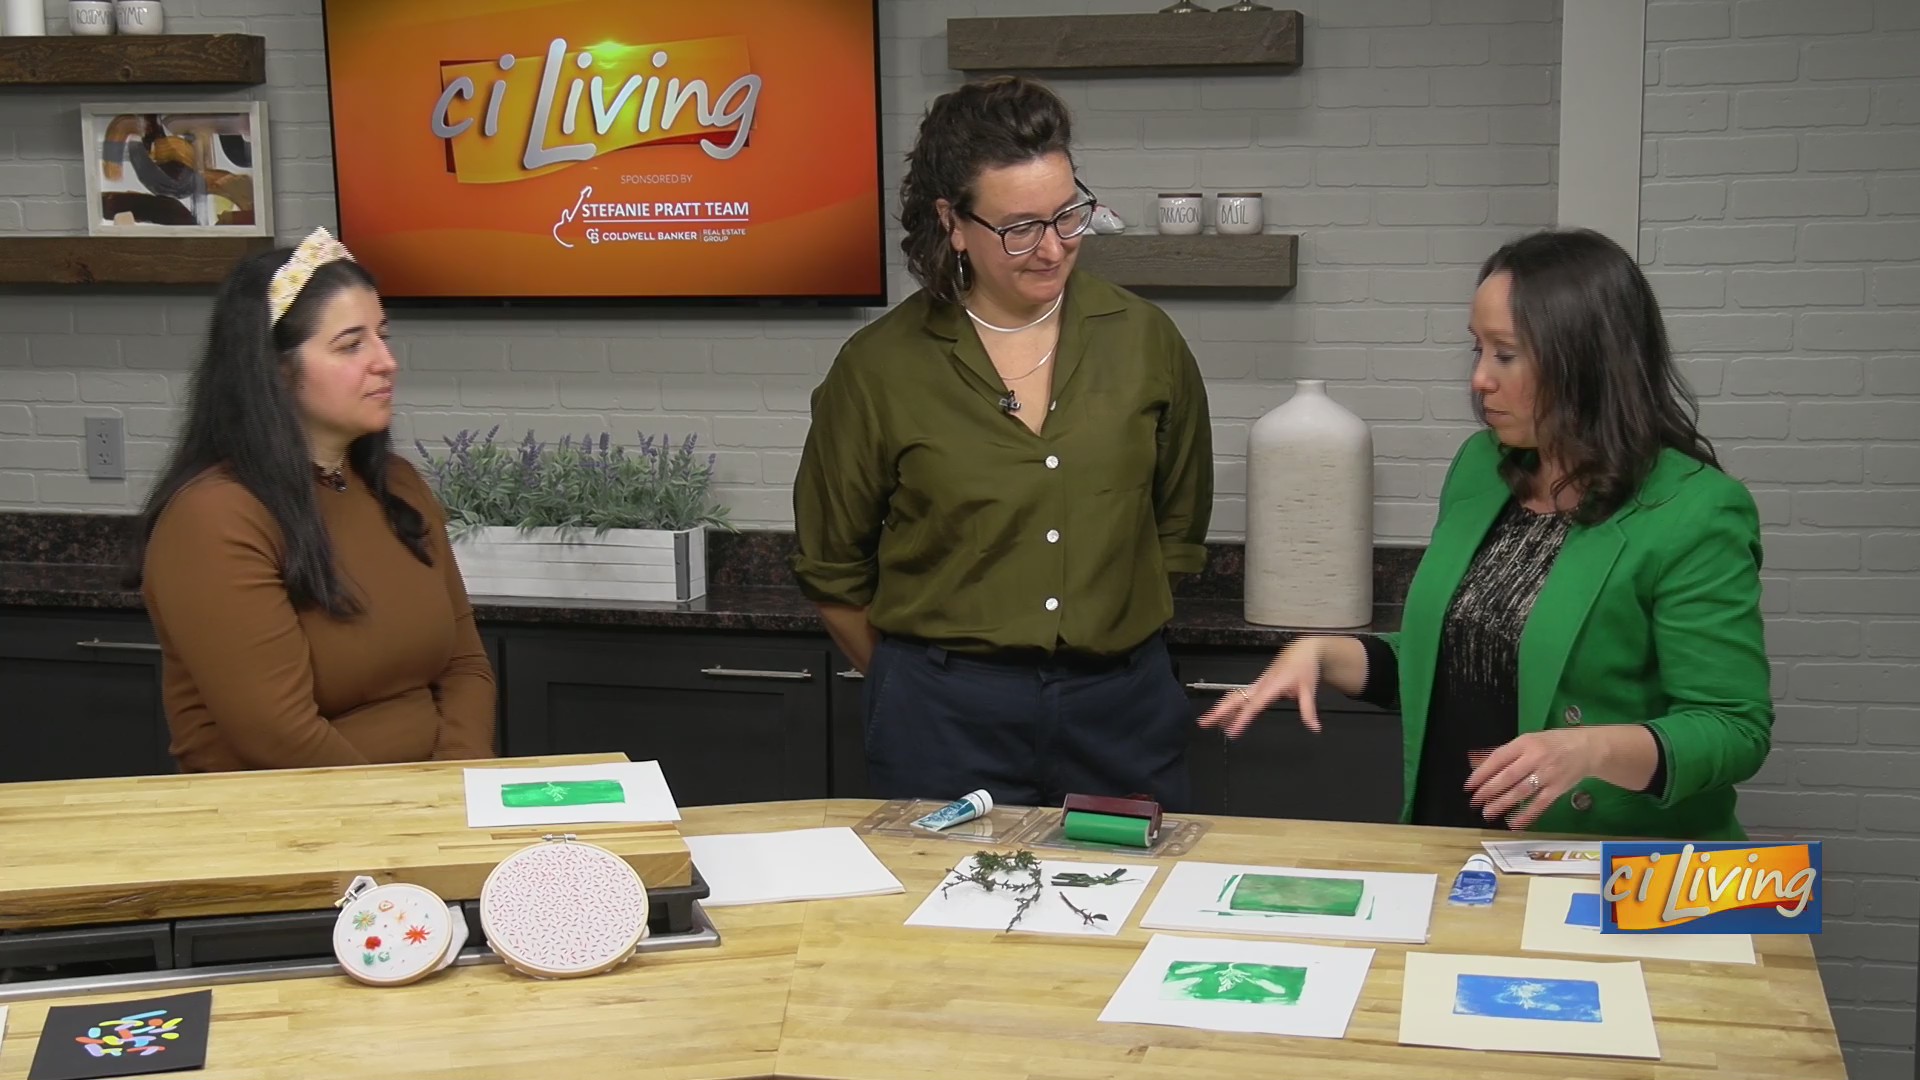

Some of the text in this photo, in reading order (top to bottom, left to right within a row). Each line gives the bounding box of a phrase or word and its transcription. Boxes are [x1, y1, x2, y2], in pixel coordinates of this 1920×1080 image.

[431, 38, 762, 170] ci Living
[621, 175, 693, 184] SPONSORED BY
[582, 202, 749, 217] STEFANIE PRATT TEAM
[1221, 205, 1249, 224] BASIL
[602, 232, 655, 241] COLDWELL
[658, 232, 697, 240] BANKER
